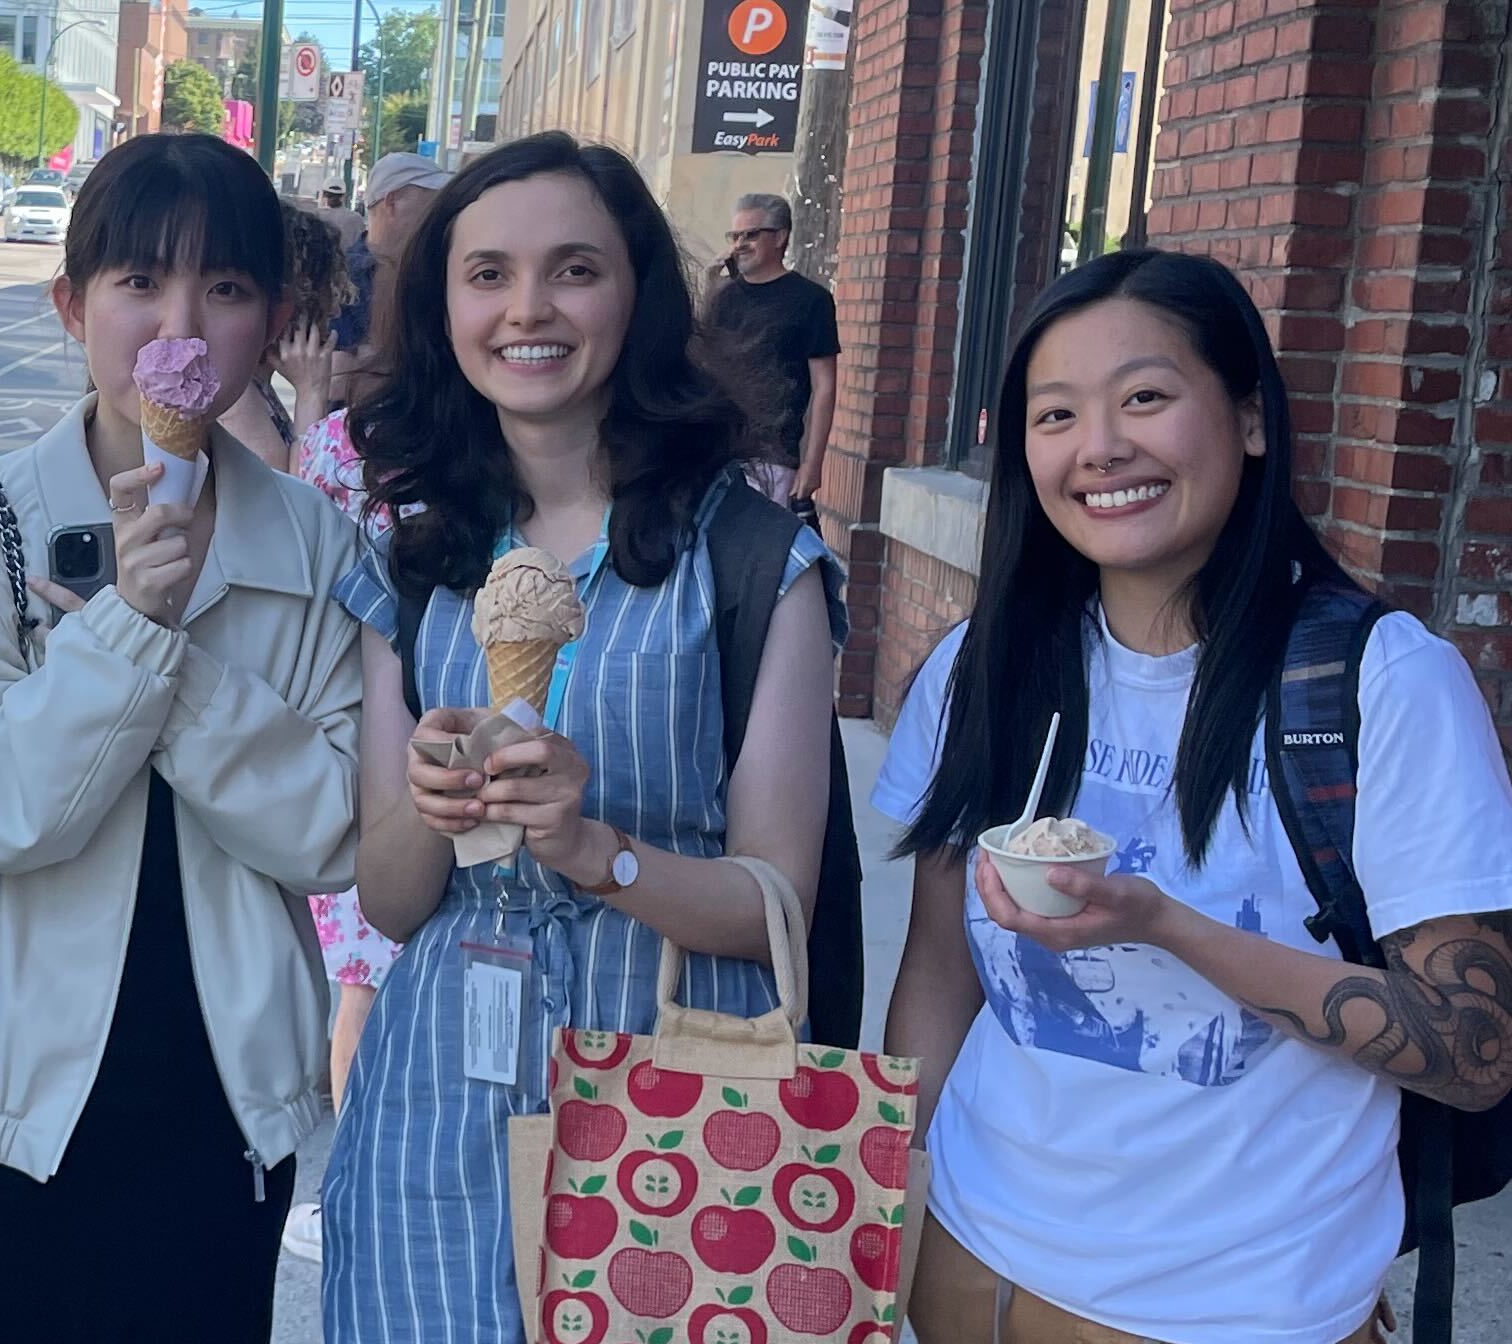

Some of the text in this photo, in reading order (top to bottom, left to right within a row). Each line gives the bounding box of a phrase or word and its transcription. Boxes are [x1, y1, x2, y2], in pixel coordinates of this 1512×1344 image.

[707, 61, 801, 80] PUBLIC PAY
[705, 79, 798, 101] PARKING
[714, 131, 780, 149] EasyPark
[1283, 731, 1344, 746] BURTON
